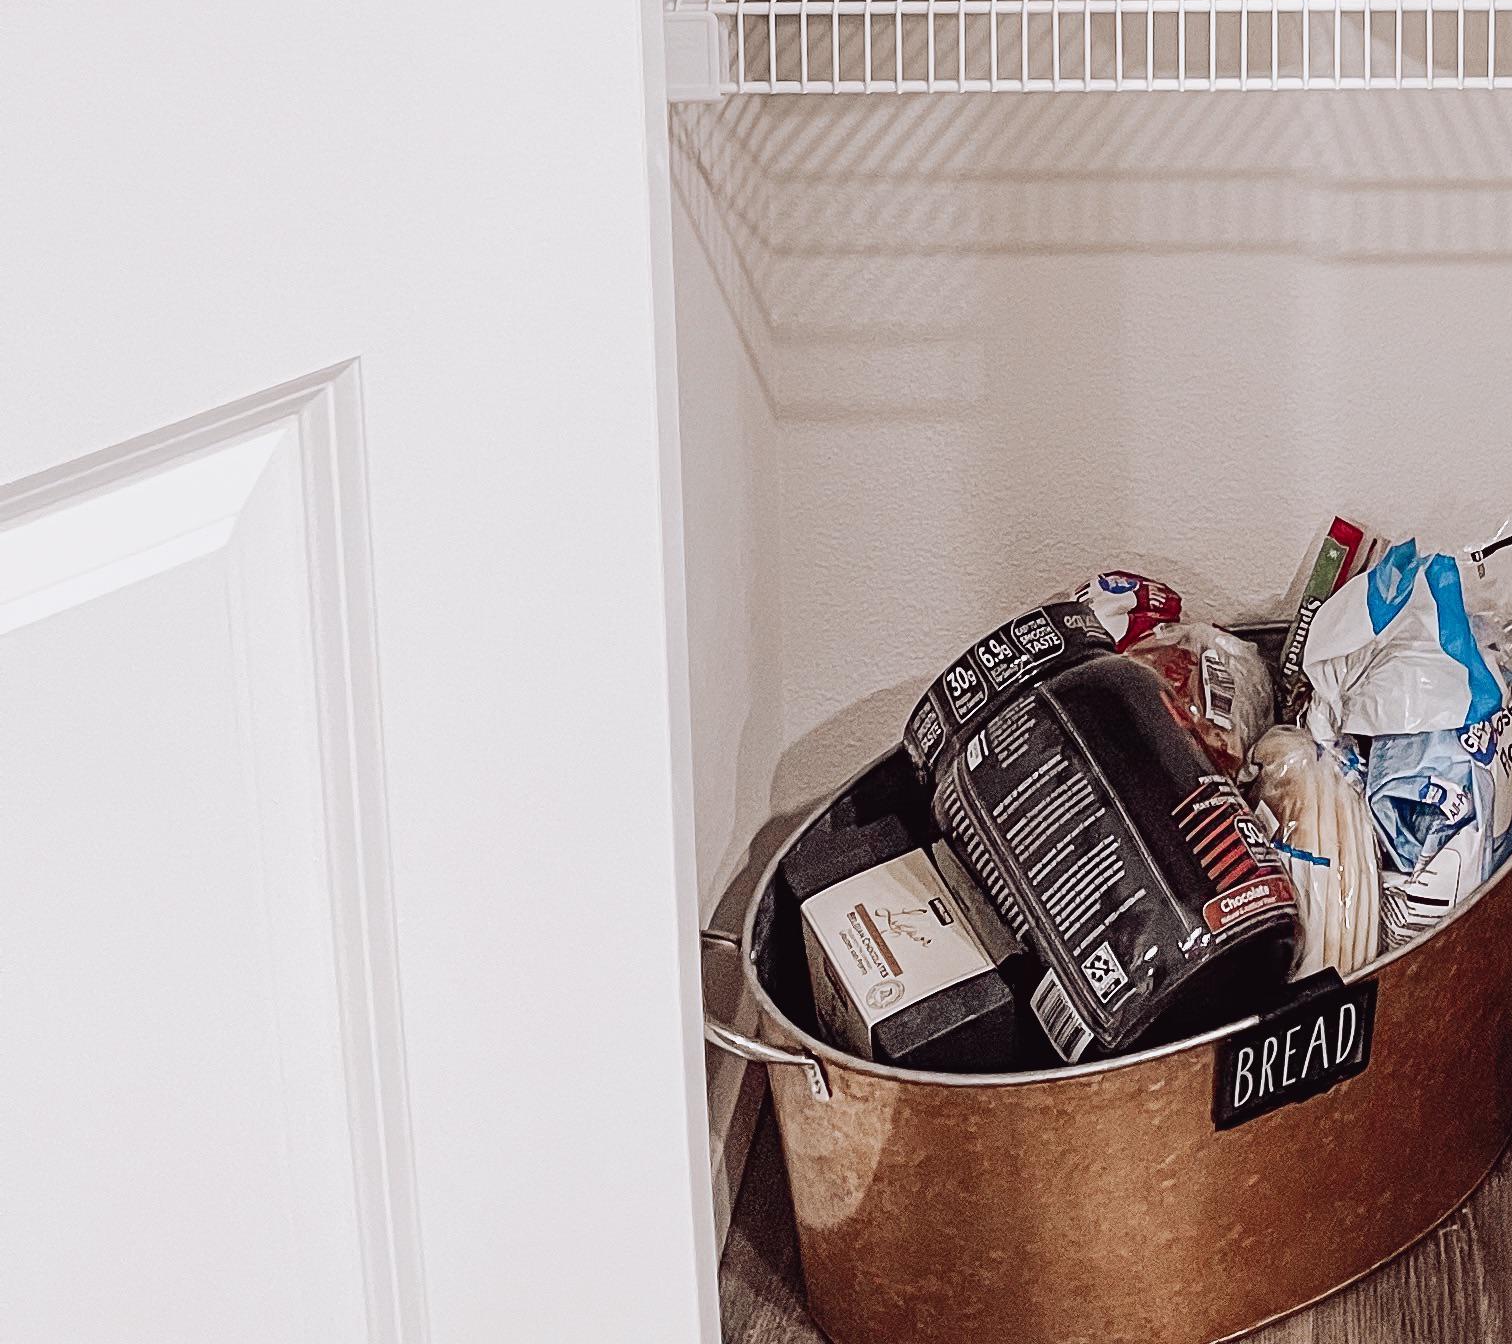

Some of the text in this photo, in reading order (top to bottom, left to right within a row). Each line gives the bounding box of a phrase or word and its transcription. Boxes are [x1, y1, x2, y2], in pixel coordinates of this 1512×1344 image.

[979, 639, 1013, 668] 6.9g
[1025, 634, 1061, 654] TASTE
[946, 667, 977, 696] 30g
[1220, 885, 1270, 913] Chocolate
[1233, 1003, 1358, 1109] BREAD
